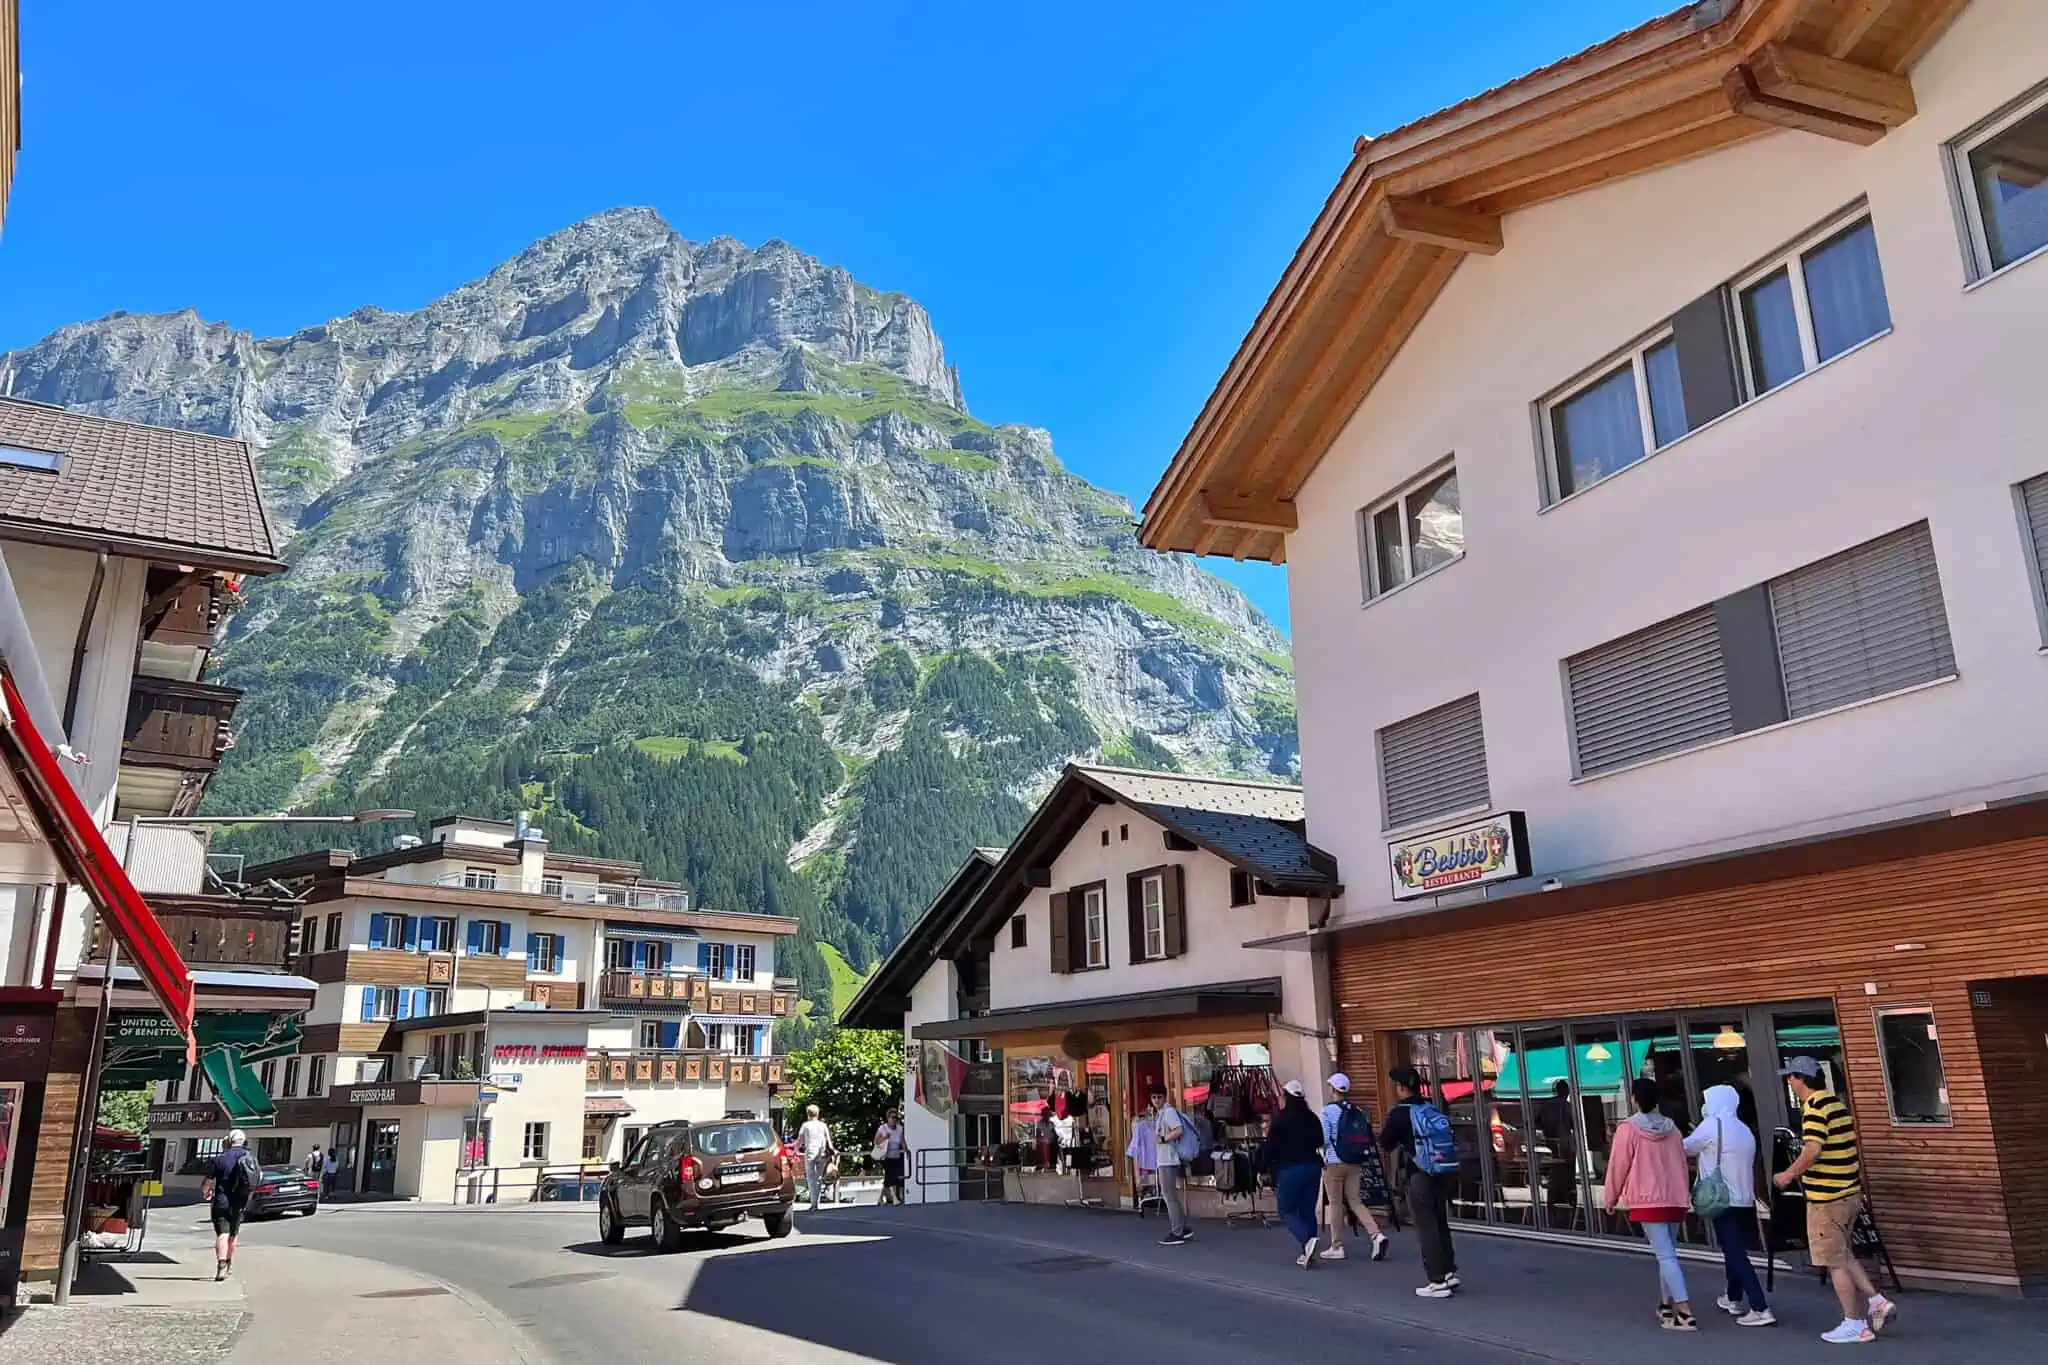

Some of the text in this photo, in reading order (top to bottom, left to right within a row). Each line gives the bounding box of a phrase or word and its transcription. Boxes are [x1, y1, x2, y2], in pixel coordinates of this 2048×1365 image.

[1424, 869, 1481, 889] RESTAURANTS
[121, 1018, 200, 1028] UNITED COS
[120, 1027, 178, 1036] OF BENETTO
[494, 1044, 538, 1058] HOTEL
